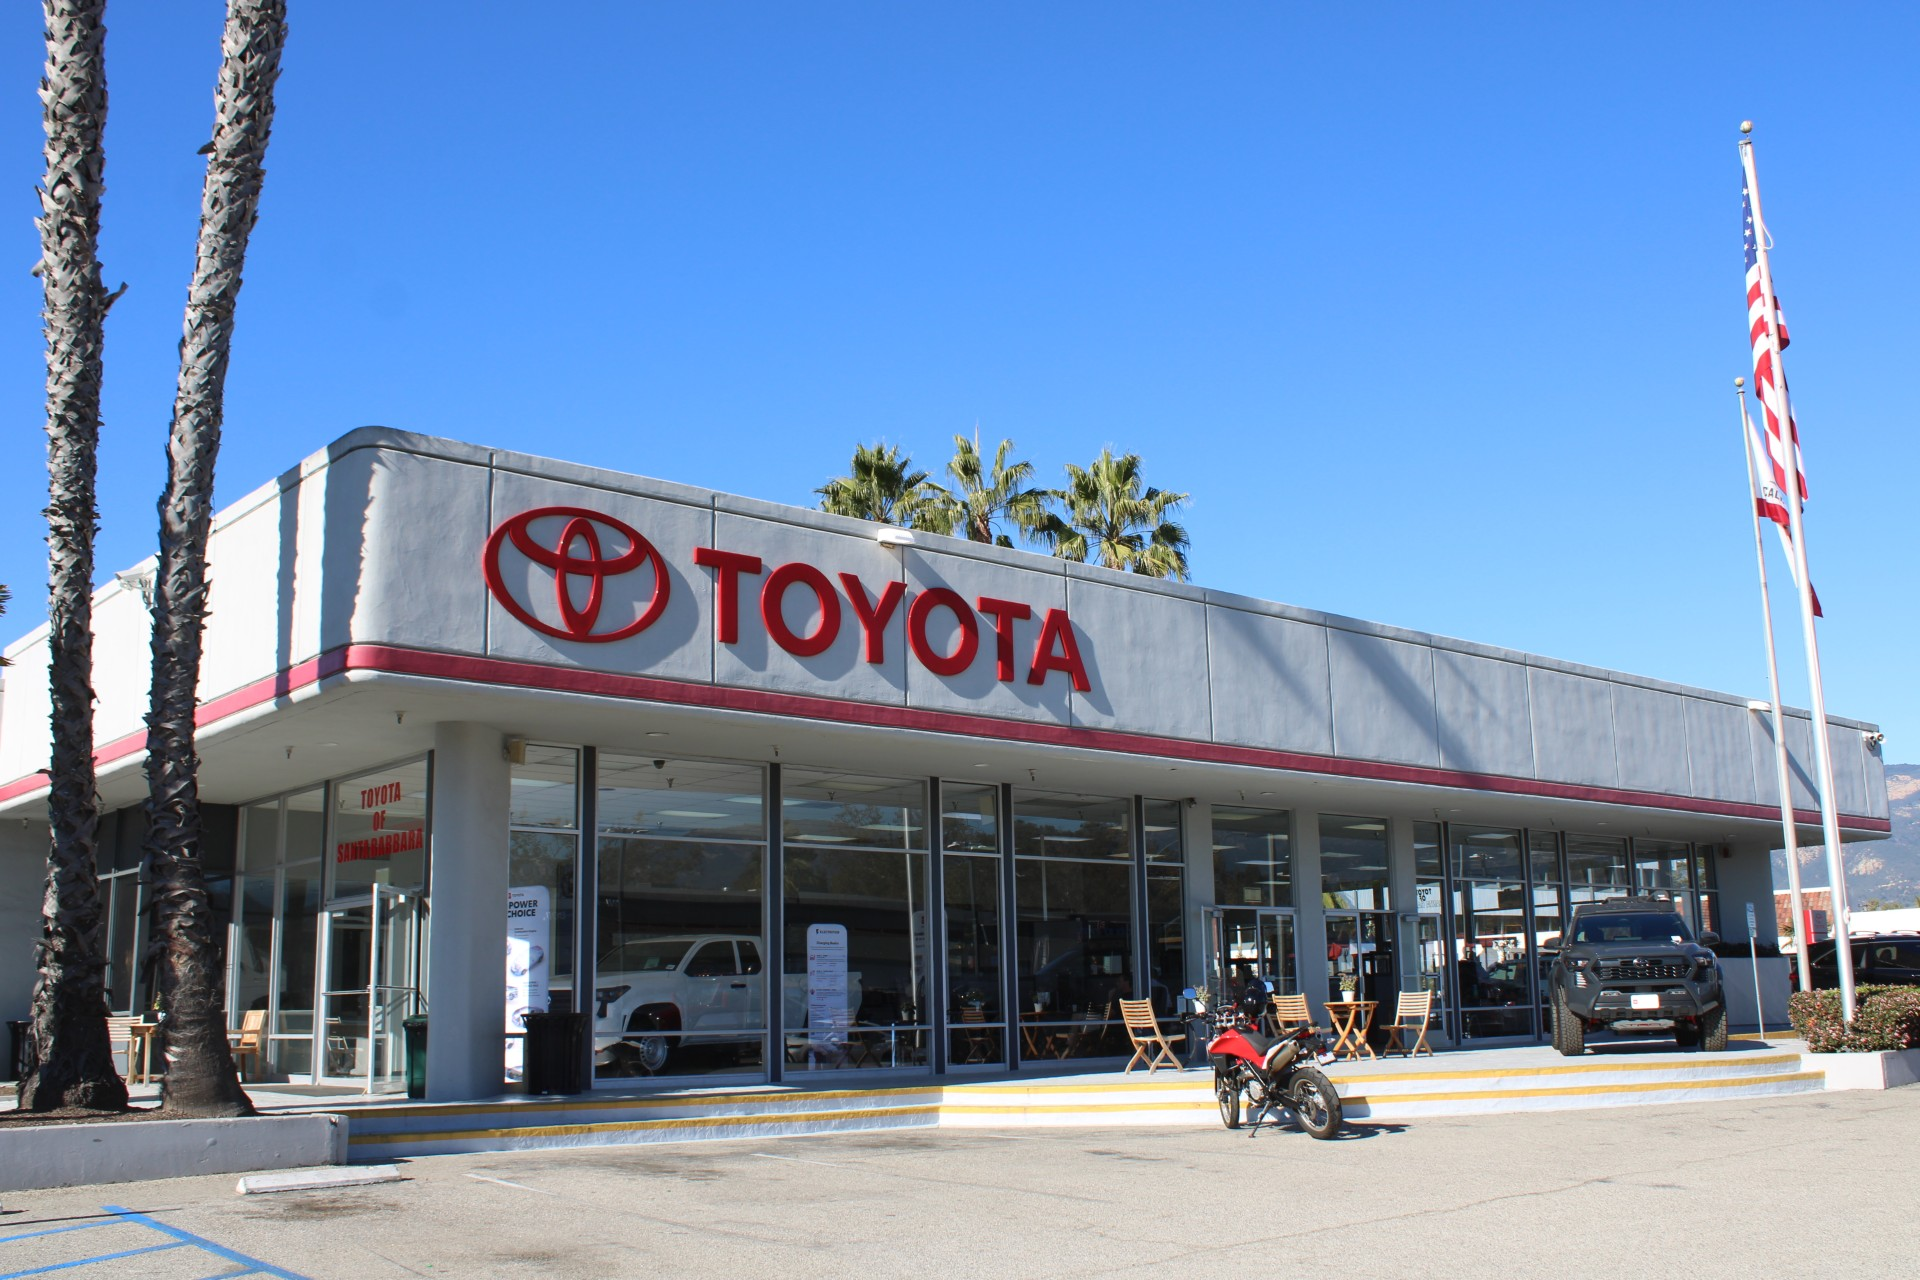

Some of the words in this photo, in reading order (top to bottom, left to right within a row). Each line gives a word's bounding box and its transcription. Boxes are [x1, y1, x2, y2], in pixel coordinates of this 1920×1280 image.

[693, 546, 1091, 692] TOYOTA
[361, 782, 401, 809] TOYOTA
[373, 809, 386, 831] OF
[508, 900, 538, 909] POWER
